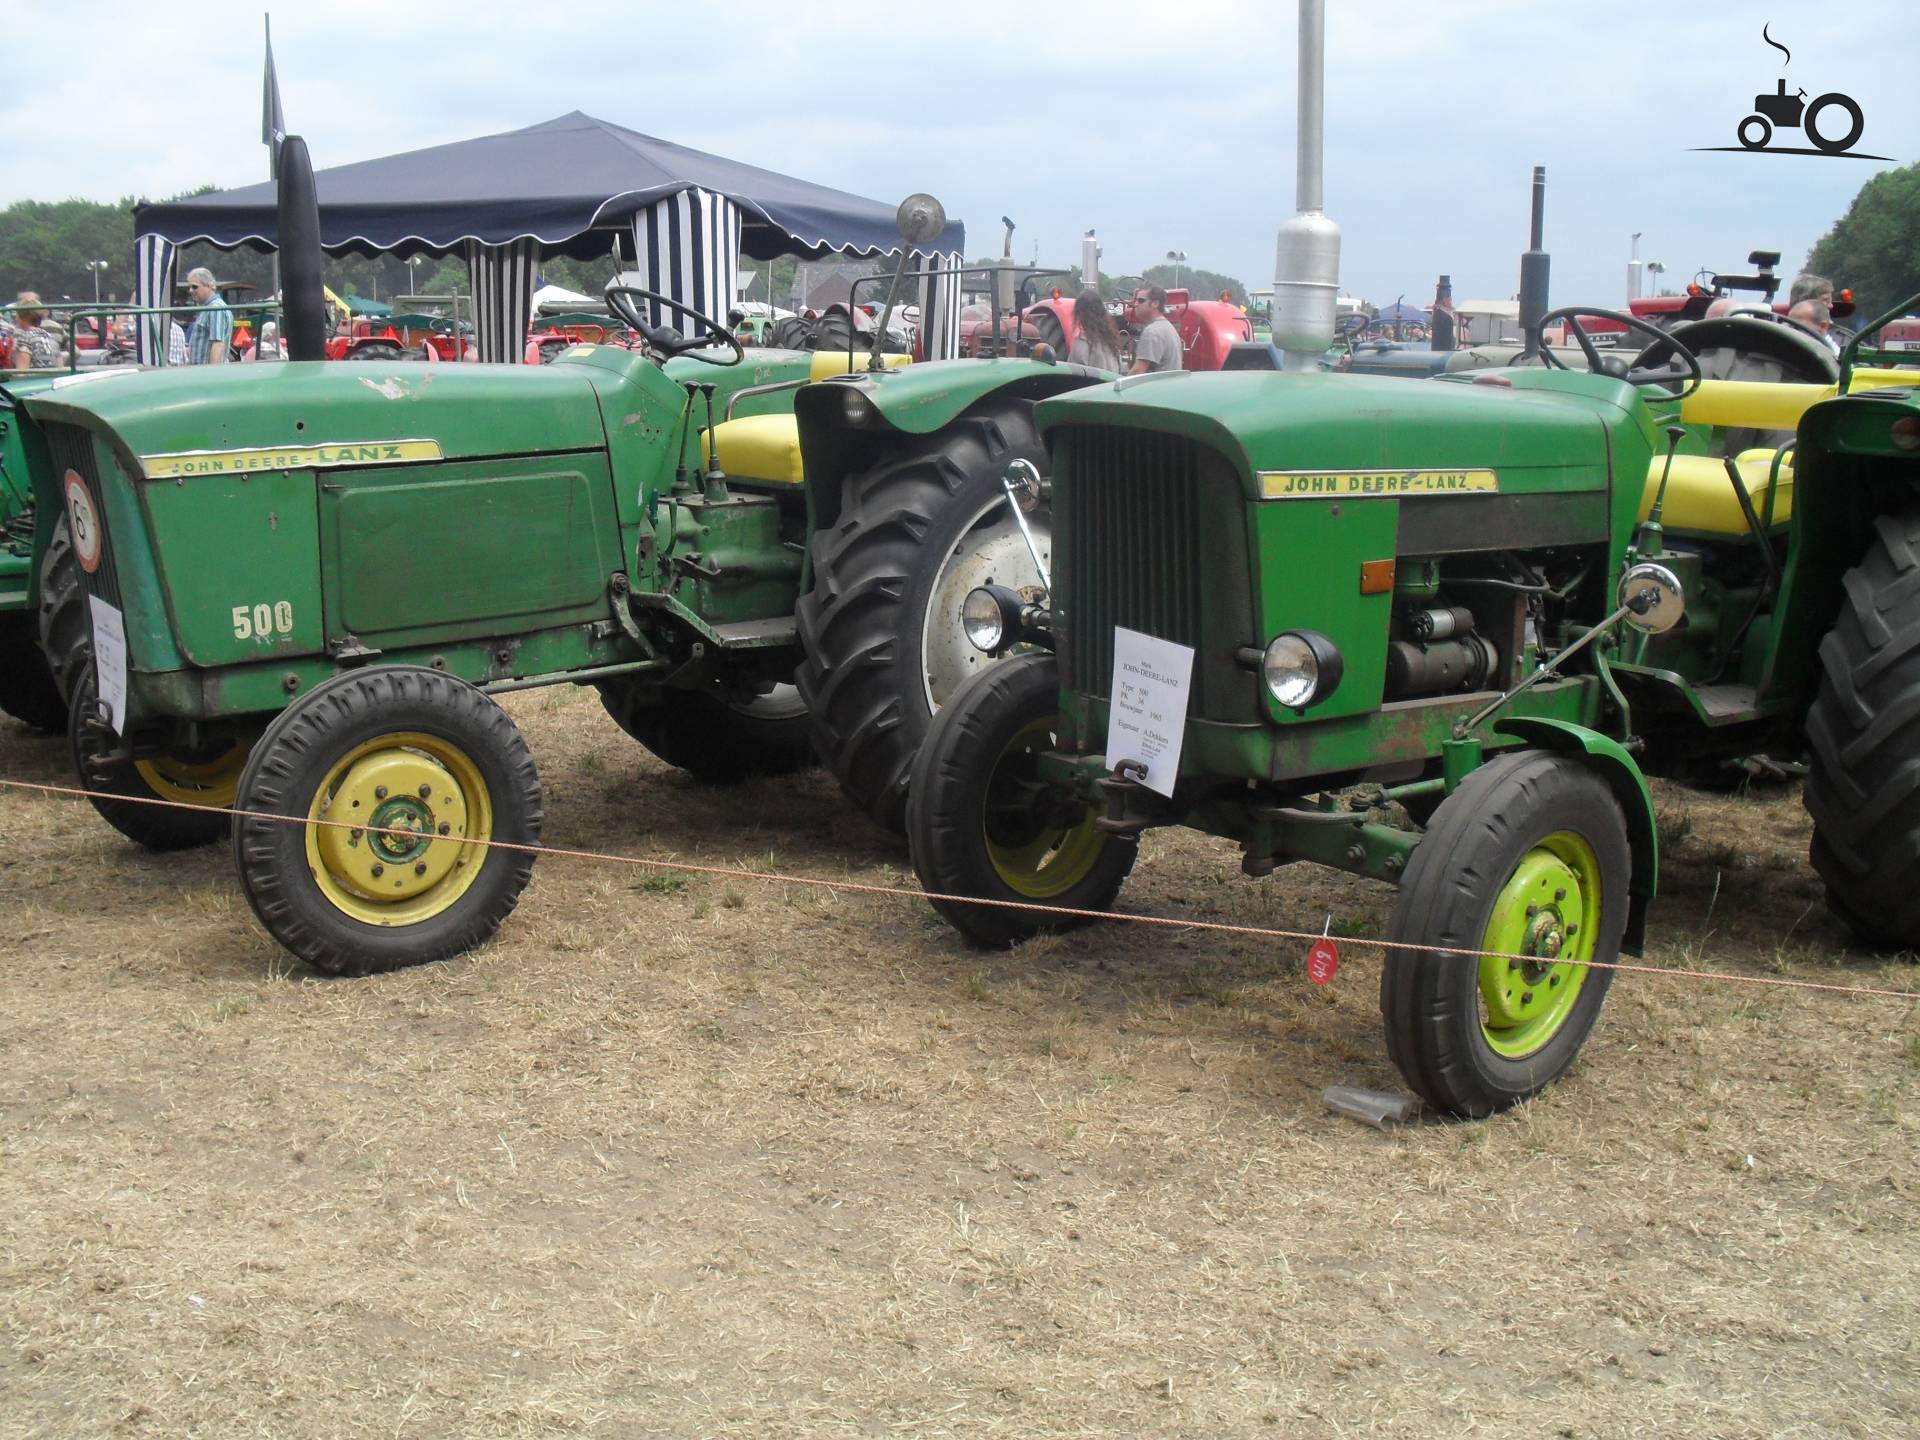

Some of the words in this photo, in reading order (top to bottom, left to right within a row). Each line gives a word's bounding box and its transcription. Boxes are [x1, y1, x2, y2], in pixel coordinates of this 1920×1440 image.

[172, 460, 224, 473] JOHN
[1284, 476, 1338, 493] JOHN
[231, 600, 293, 640] 500
[1121, 681, 1135, 693] Type
